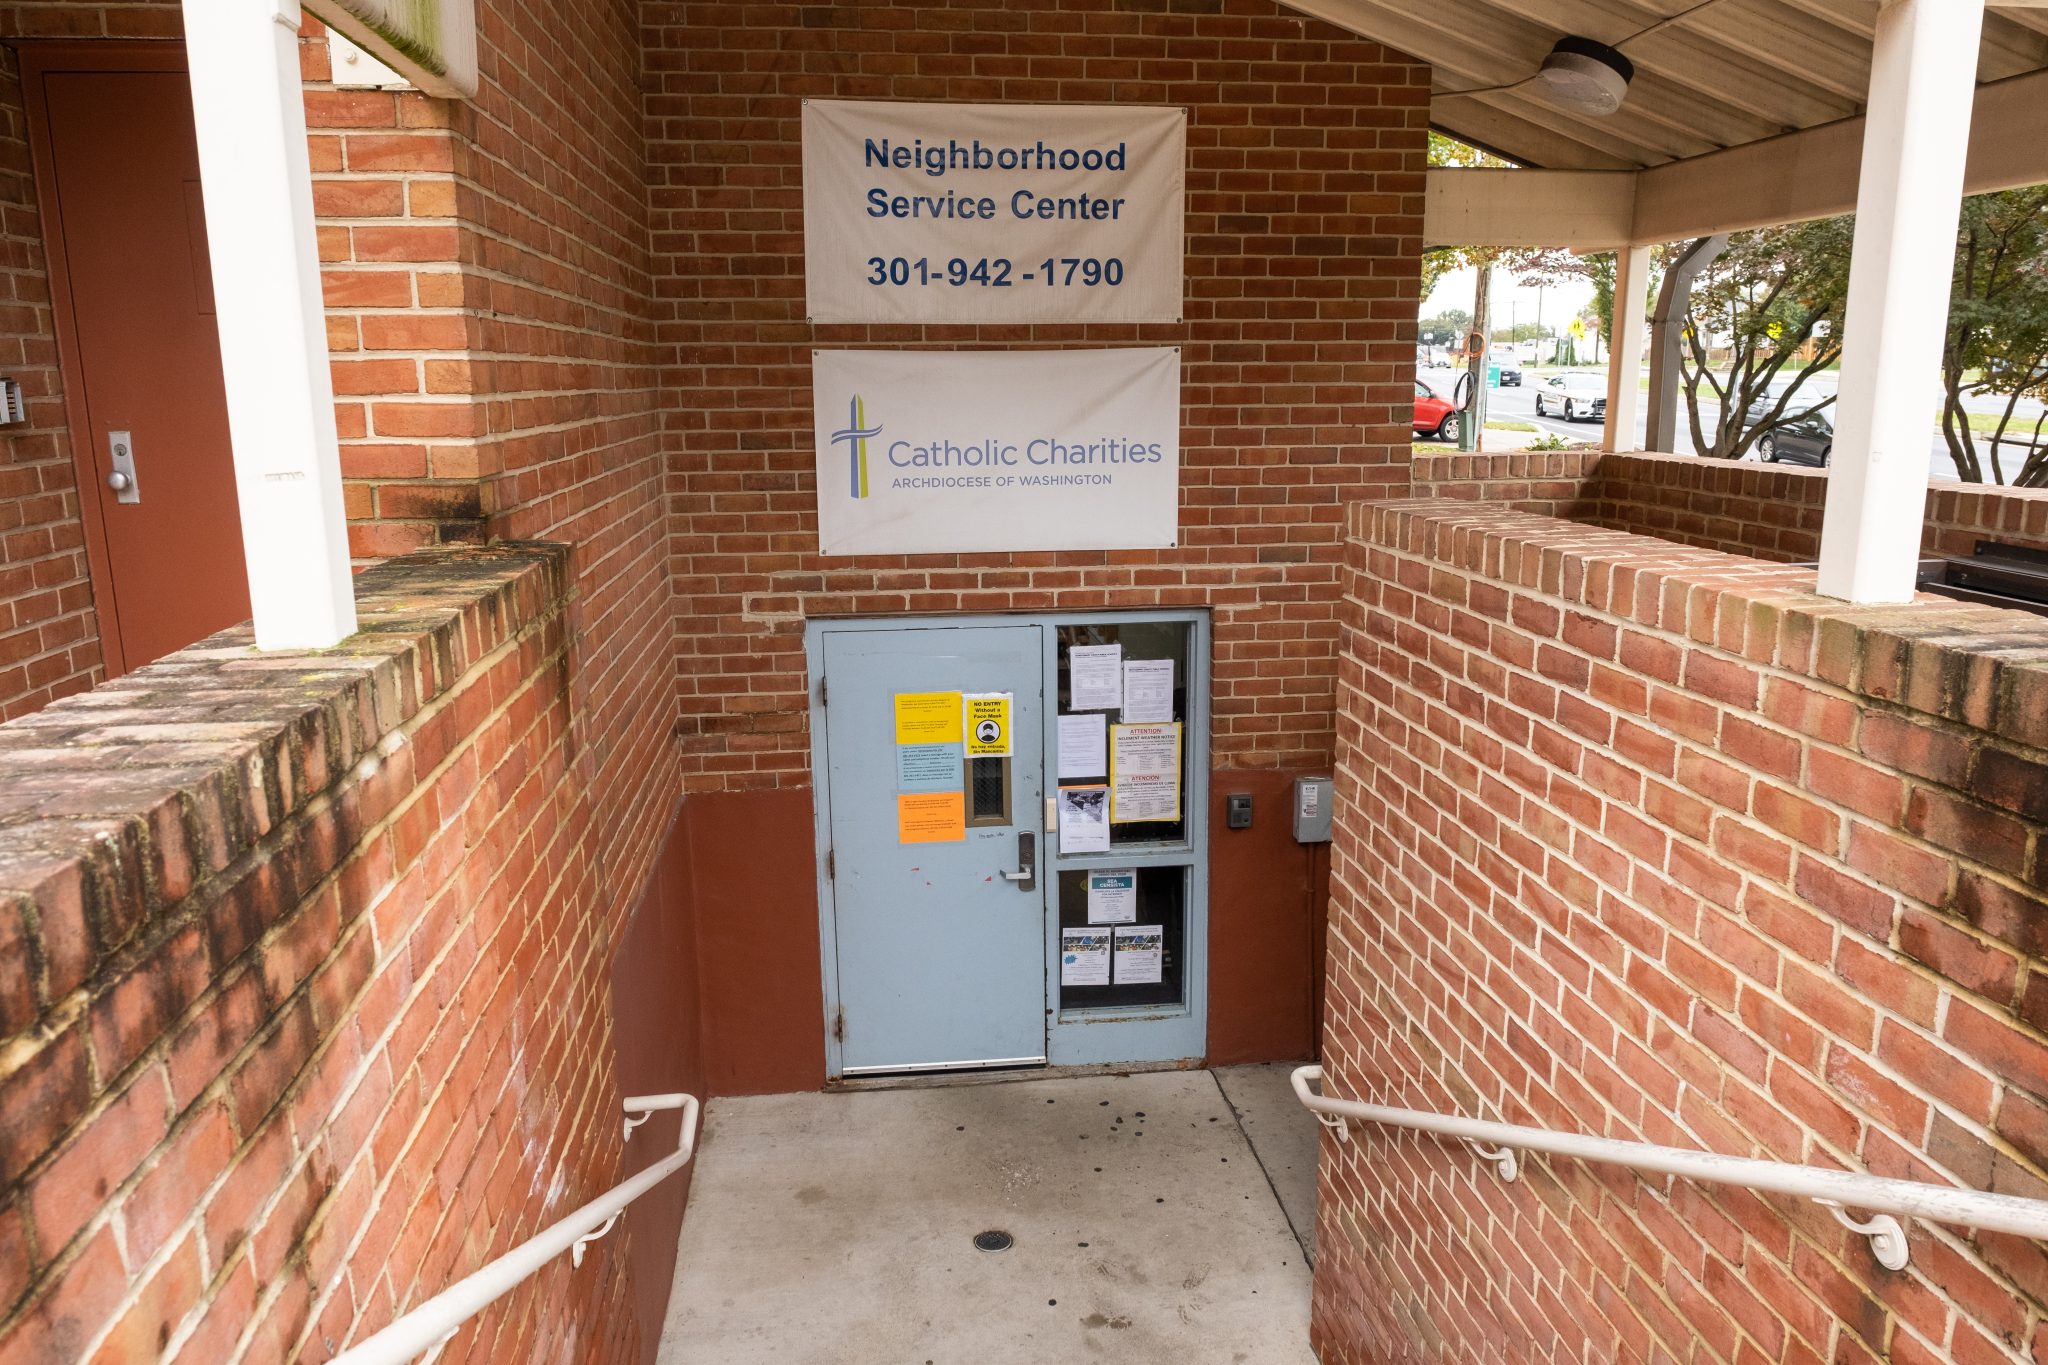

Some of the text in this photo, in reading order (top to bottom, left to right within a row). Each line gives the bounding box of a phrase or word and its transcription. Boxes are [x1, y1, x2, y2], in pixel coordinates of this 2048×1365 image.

[865, 138, 1126, 176] Neighborhood
[866, 188, 1125, 220] Service Center
[888, 437, 1162, 467] Catholic Charities
[892, 474, 1112, 488] ARCHDIOCESE OF WASHINGTON
